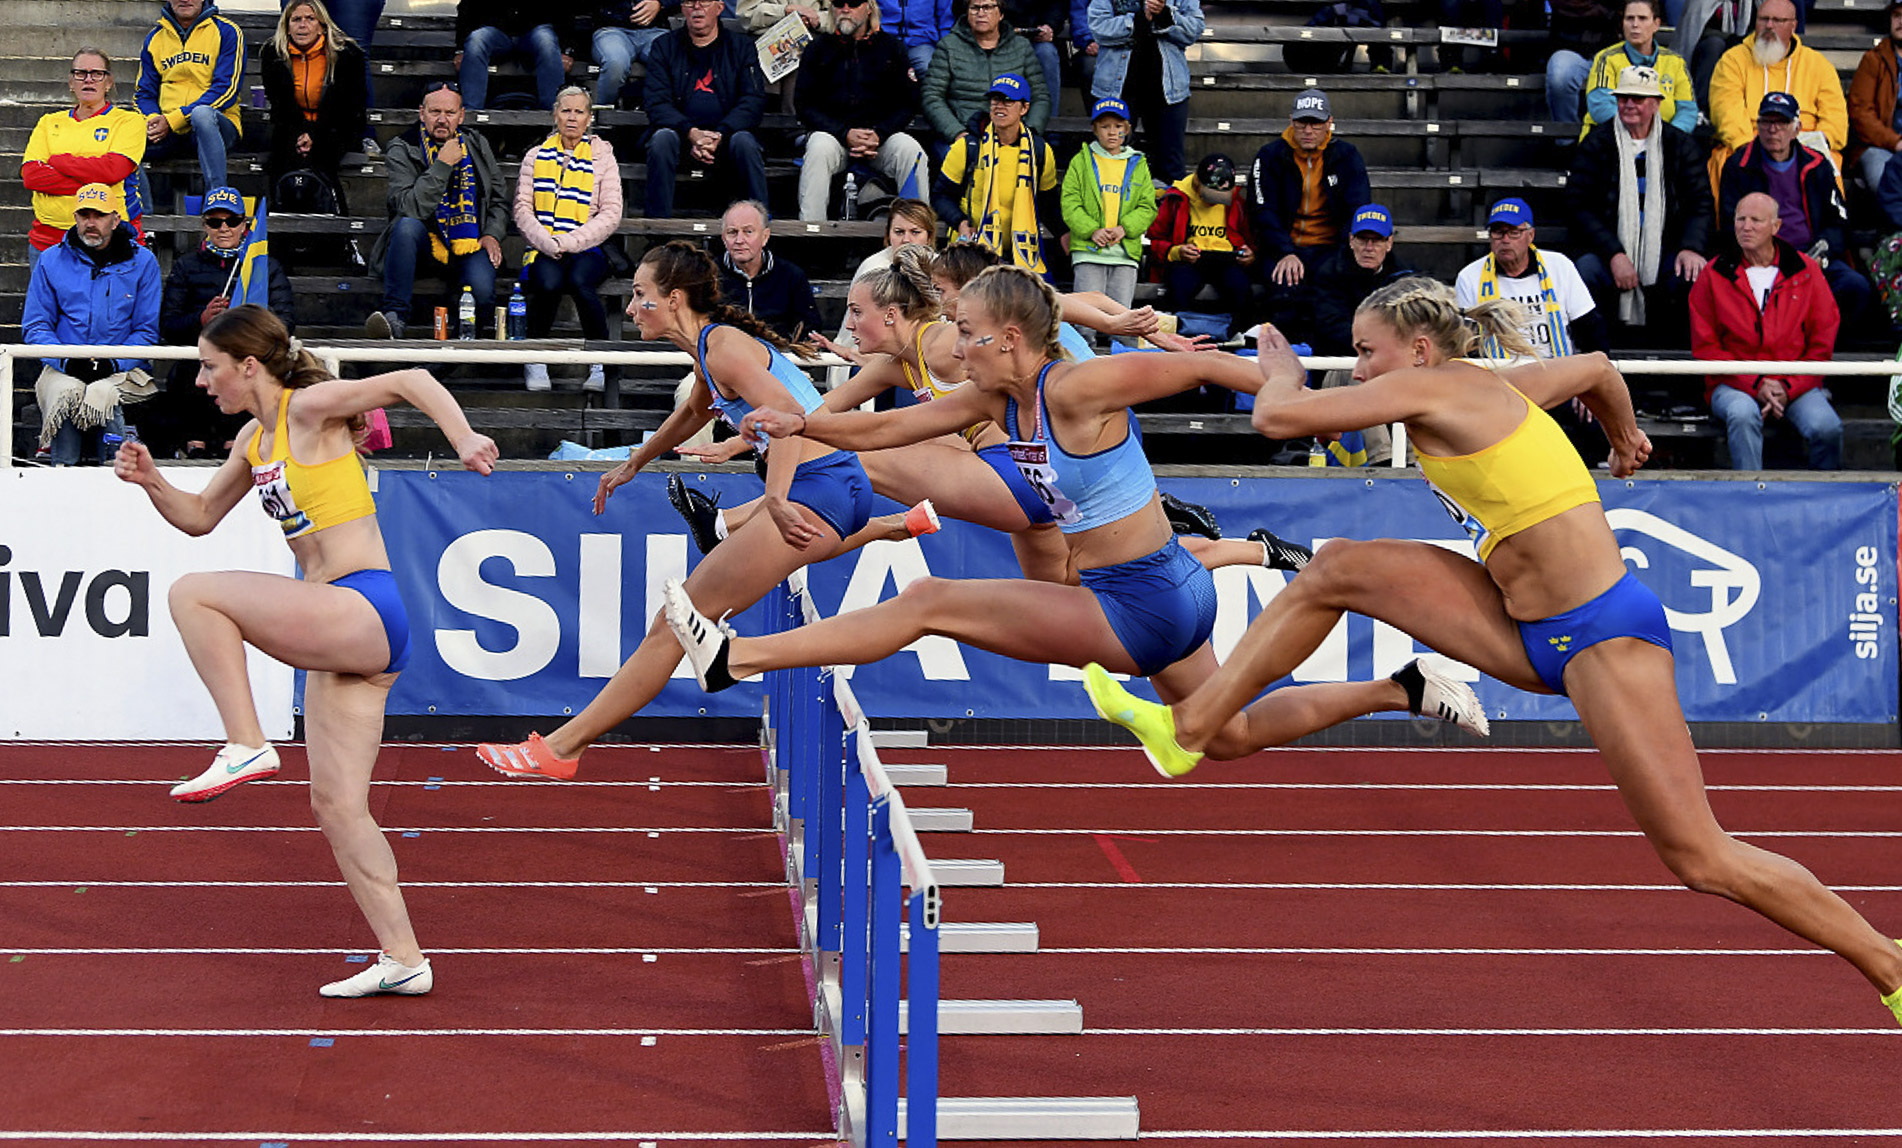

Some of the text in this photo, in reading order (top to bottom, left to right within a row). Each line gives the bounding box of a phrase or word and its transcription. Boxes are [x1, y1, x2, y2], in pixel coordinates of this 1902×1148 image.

[160, 51, 210, 71] SWEDEN
[434, 528, 972, 682] SILA
[1849, 546, 1884, 660] silja.se
